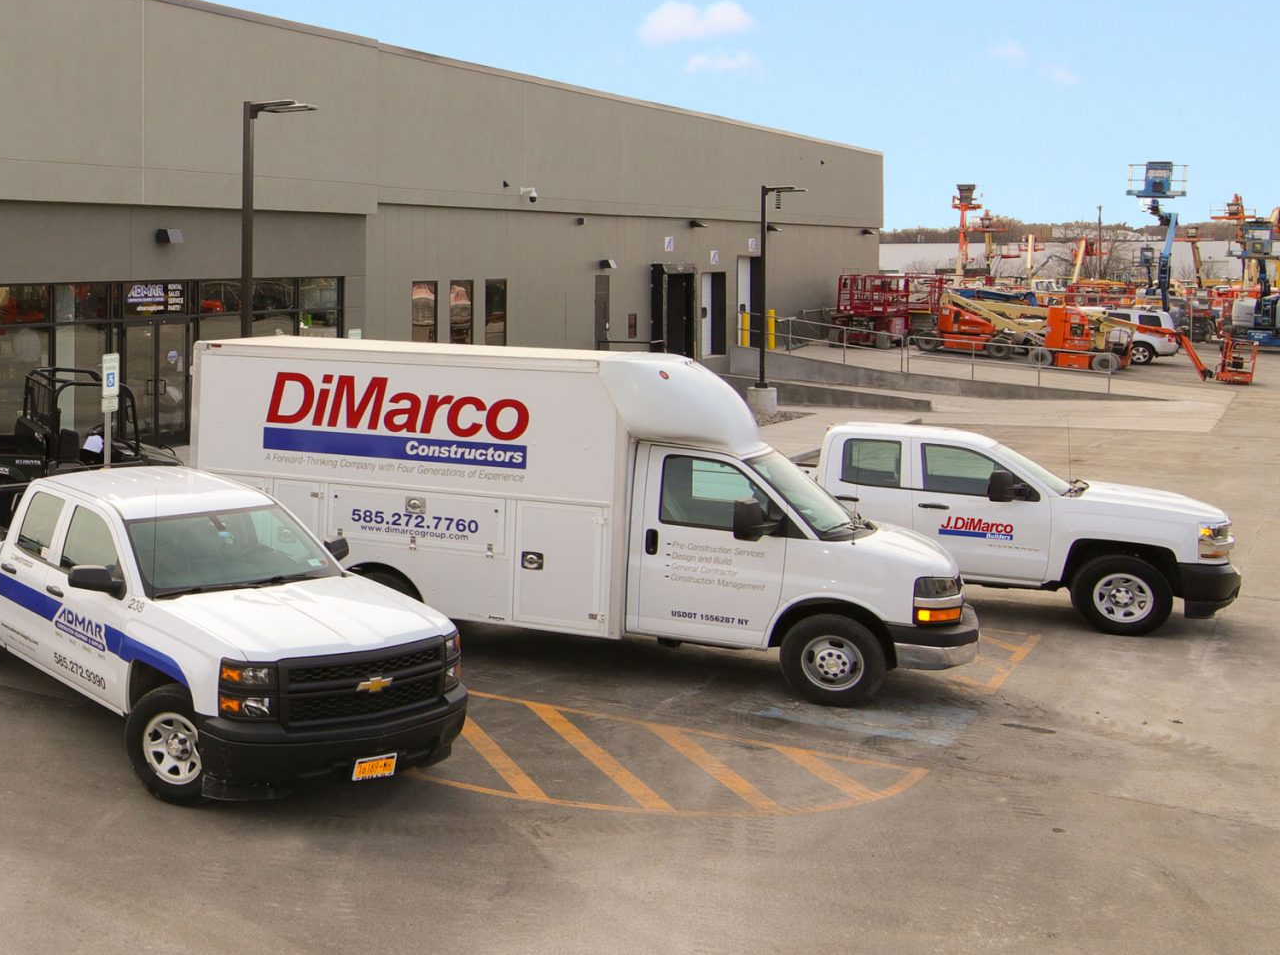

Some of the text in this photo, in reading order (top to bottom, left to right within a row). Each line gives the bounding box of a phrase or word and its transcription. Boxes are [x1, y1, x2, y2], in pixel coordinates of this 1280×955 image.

[128, 285, 165, 297] ADMAR
[265, 371, 530, 441] DiMarco
[405, 441, 524, 464] Constructors
[264, 453, 525, 483] A Forward-Thinking Company with Four Generations of Experience
[351, 509, 479, 534] 585.272.7760
[941, 516, 1013, 534] J.DiMarco
[360, 524, 469, 541] www.dimarcogroup.com
[671, 552, 732, 565] Design and Build
[672, 541, 765, 558] Pre-Construction Services
[671, 563, 738, 576] General Contractor
[670, 573, 765, 591] Construction Management
[128, 598, 144, 613] 238
[58, 608, 103, 640] ADMAR
[671, 610, 697, 620] USDOT
[737, 618, 749, 626] NY
[54, 652, 106, 690] 585.272.9390
